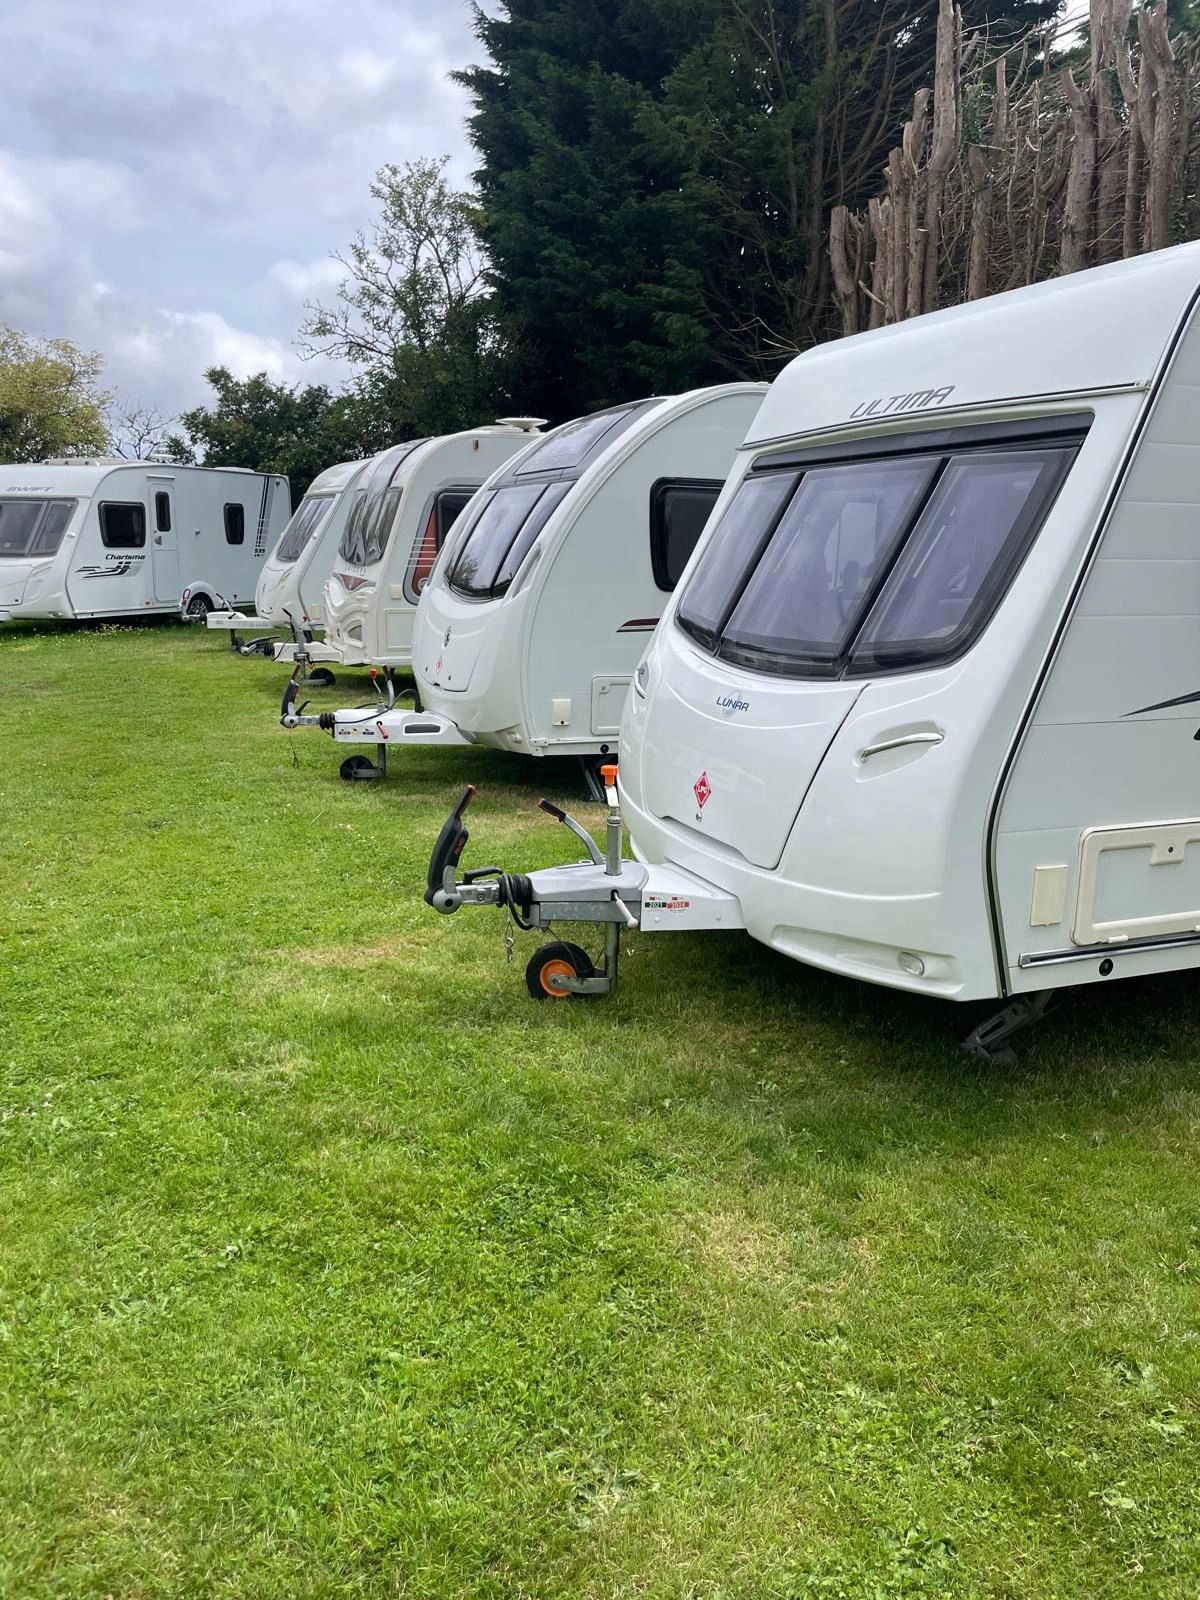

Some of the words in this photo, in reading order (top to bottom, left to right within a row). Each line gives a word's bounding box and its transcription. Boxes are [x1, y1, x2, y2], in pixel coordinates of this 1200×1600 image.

[849, 385, 956, 419] ULTIMA
[105, 553, 146, 561] Charisma
[716, 695, 750, 712] LUNAR
